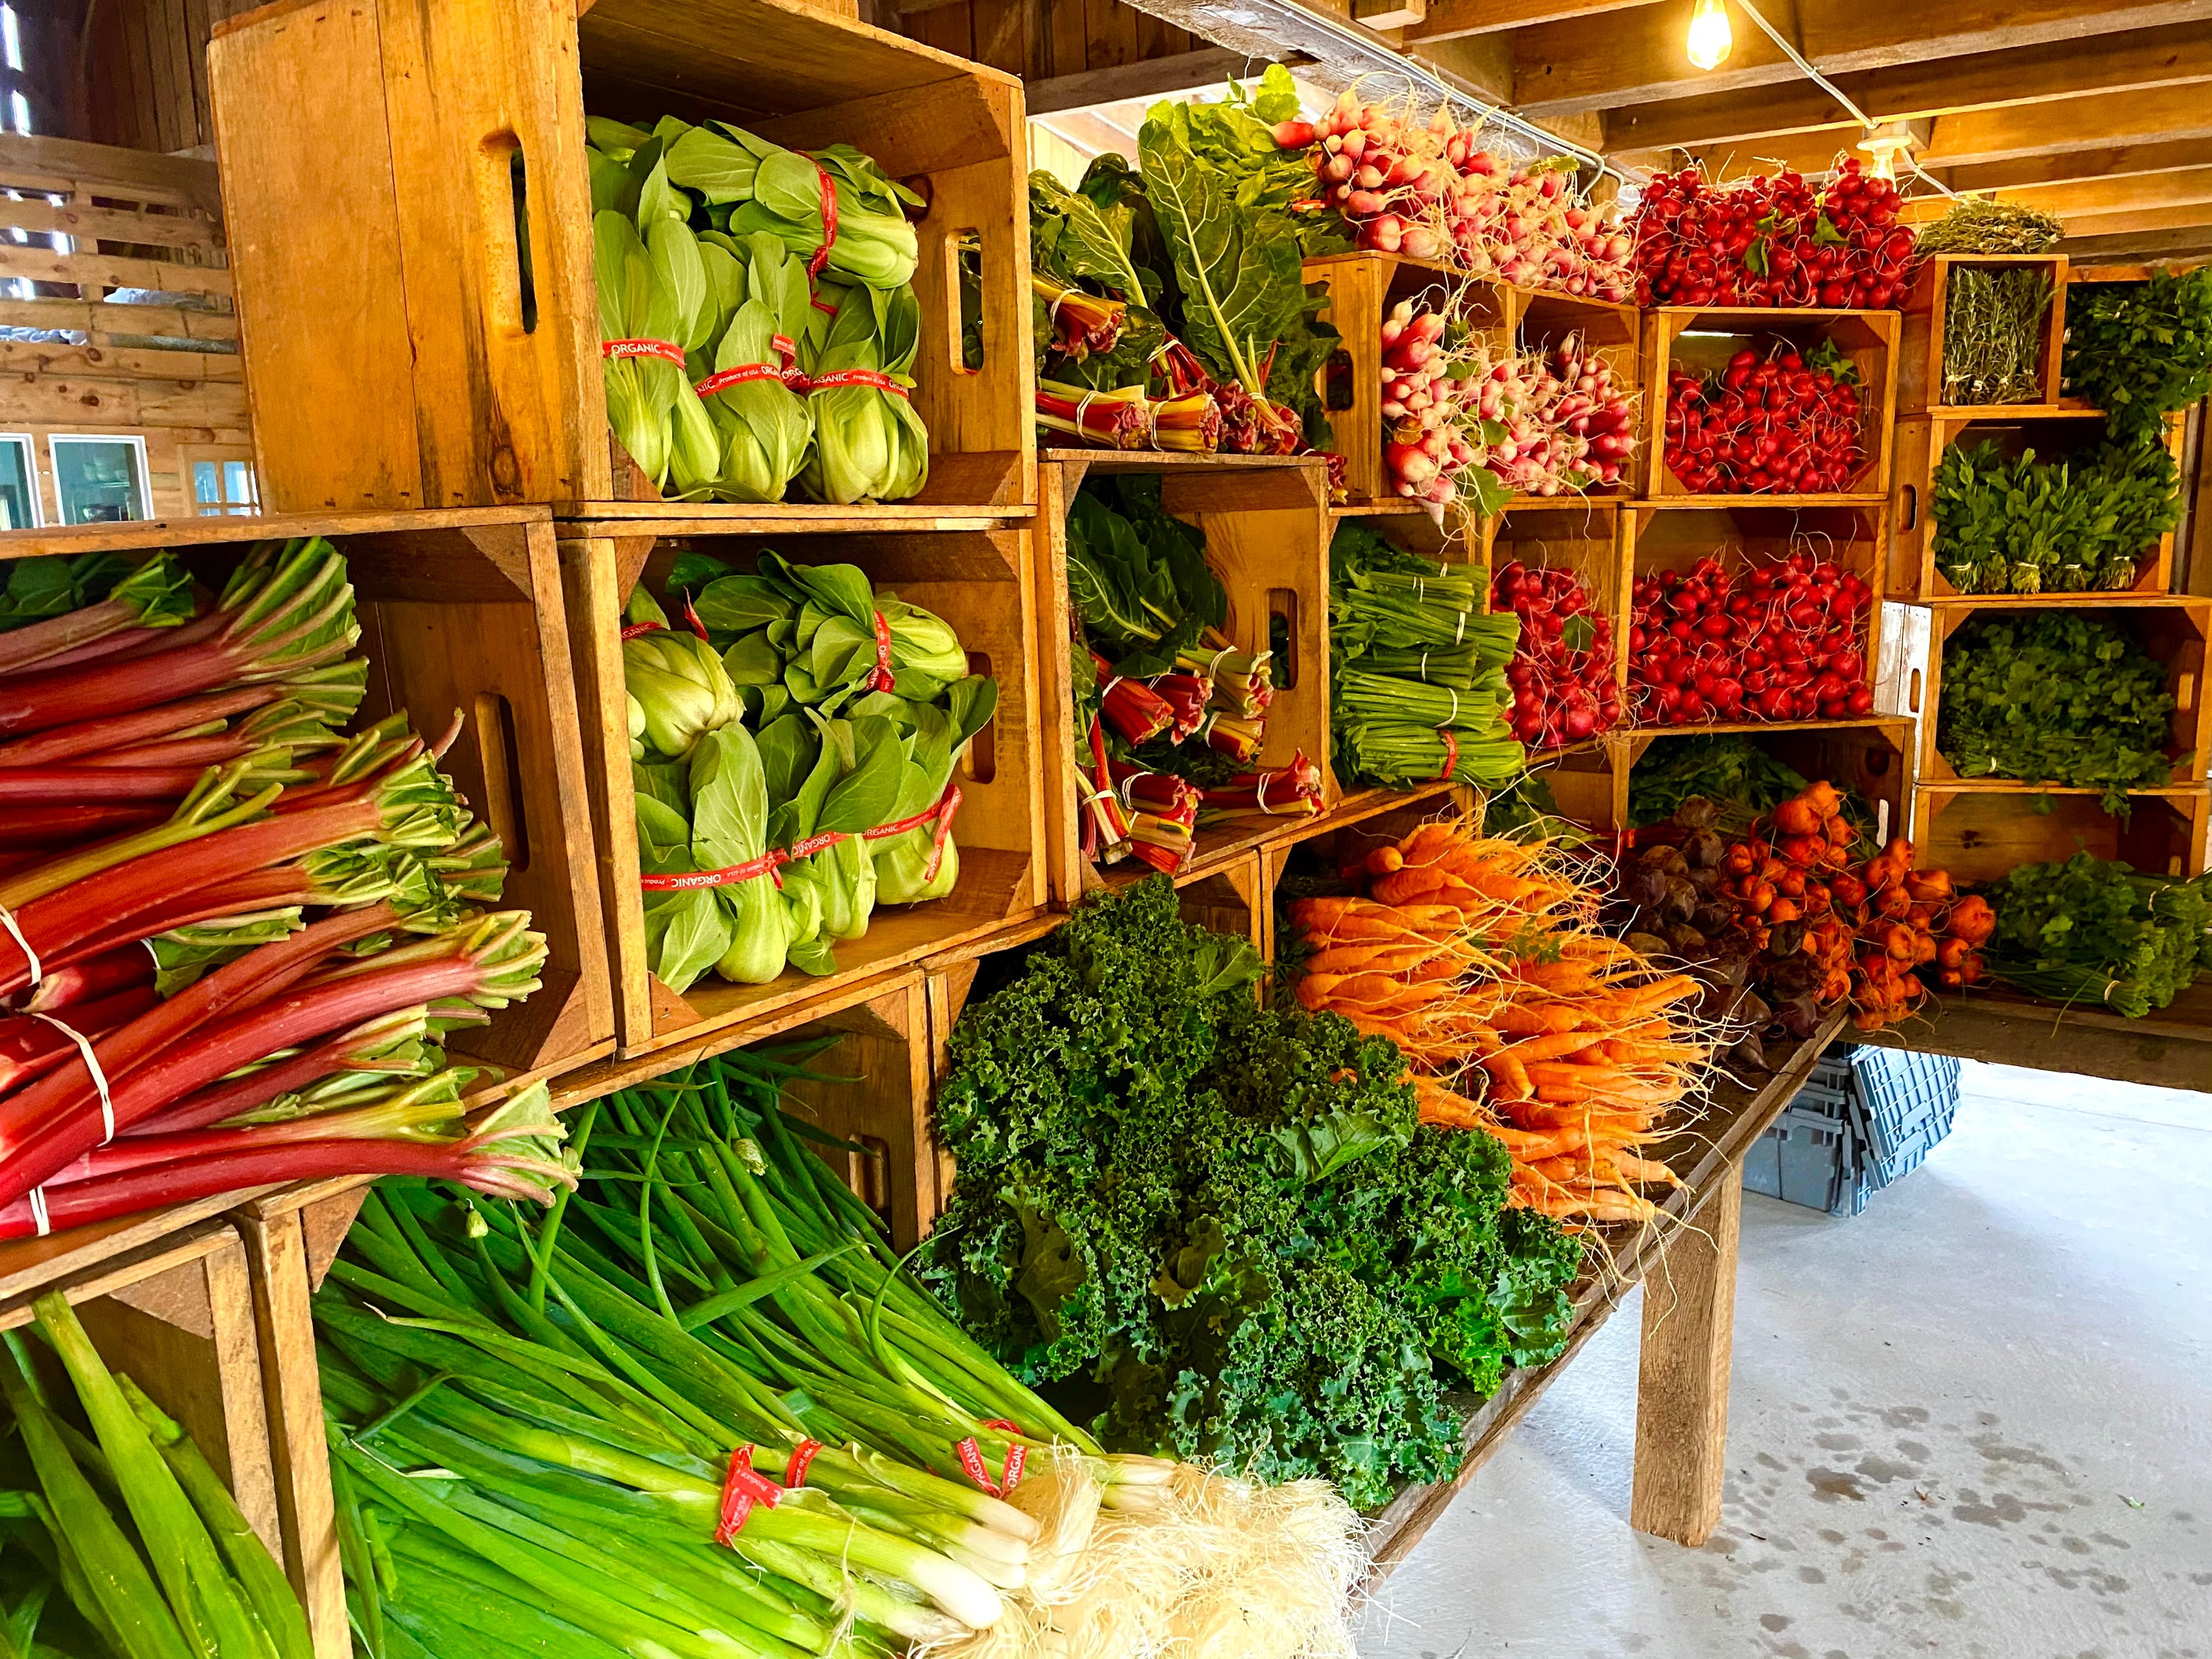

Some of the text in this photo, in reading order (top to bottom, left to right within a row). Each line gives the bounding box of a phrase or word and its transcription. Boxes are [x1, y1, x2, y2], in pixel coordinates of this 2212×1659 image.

[611, 343, 662, 355] ORGANIC
[718, 373, 741, 384] Produce
[621, 624, 651, 639] GANIC
[792, 833, 831, 855] ORGANIC
[670, 874, 722, 889] ORGANIC
[798, 1457, 807, 1468] of
[740, 1471, 769, 1492] Produce
